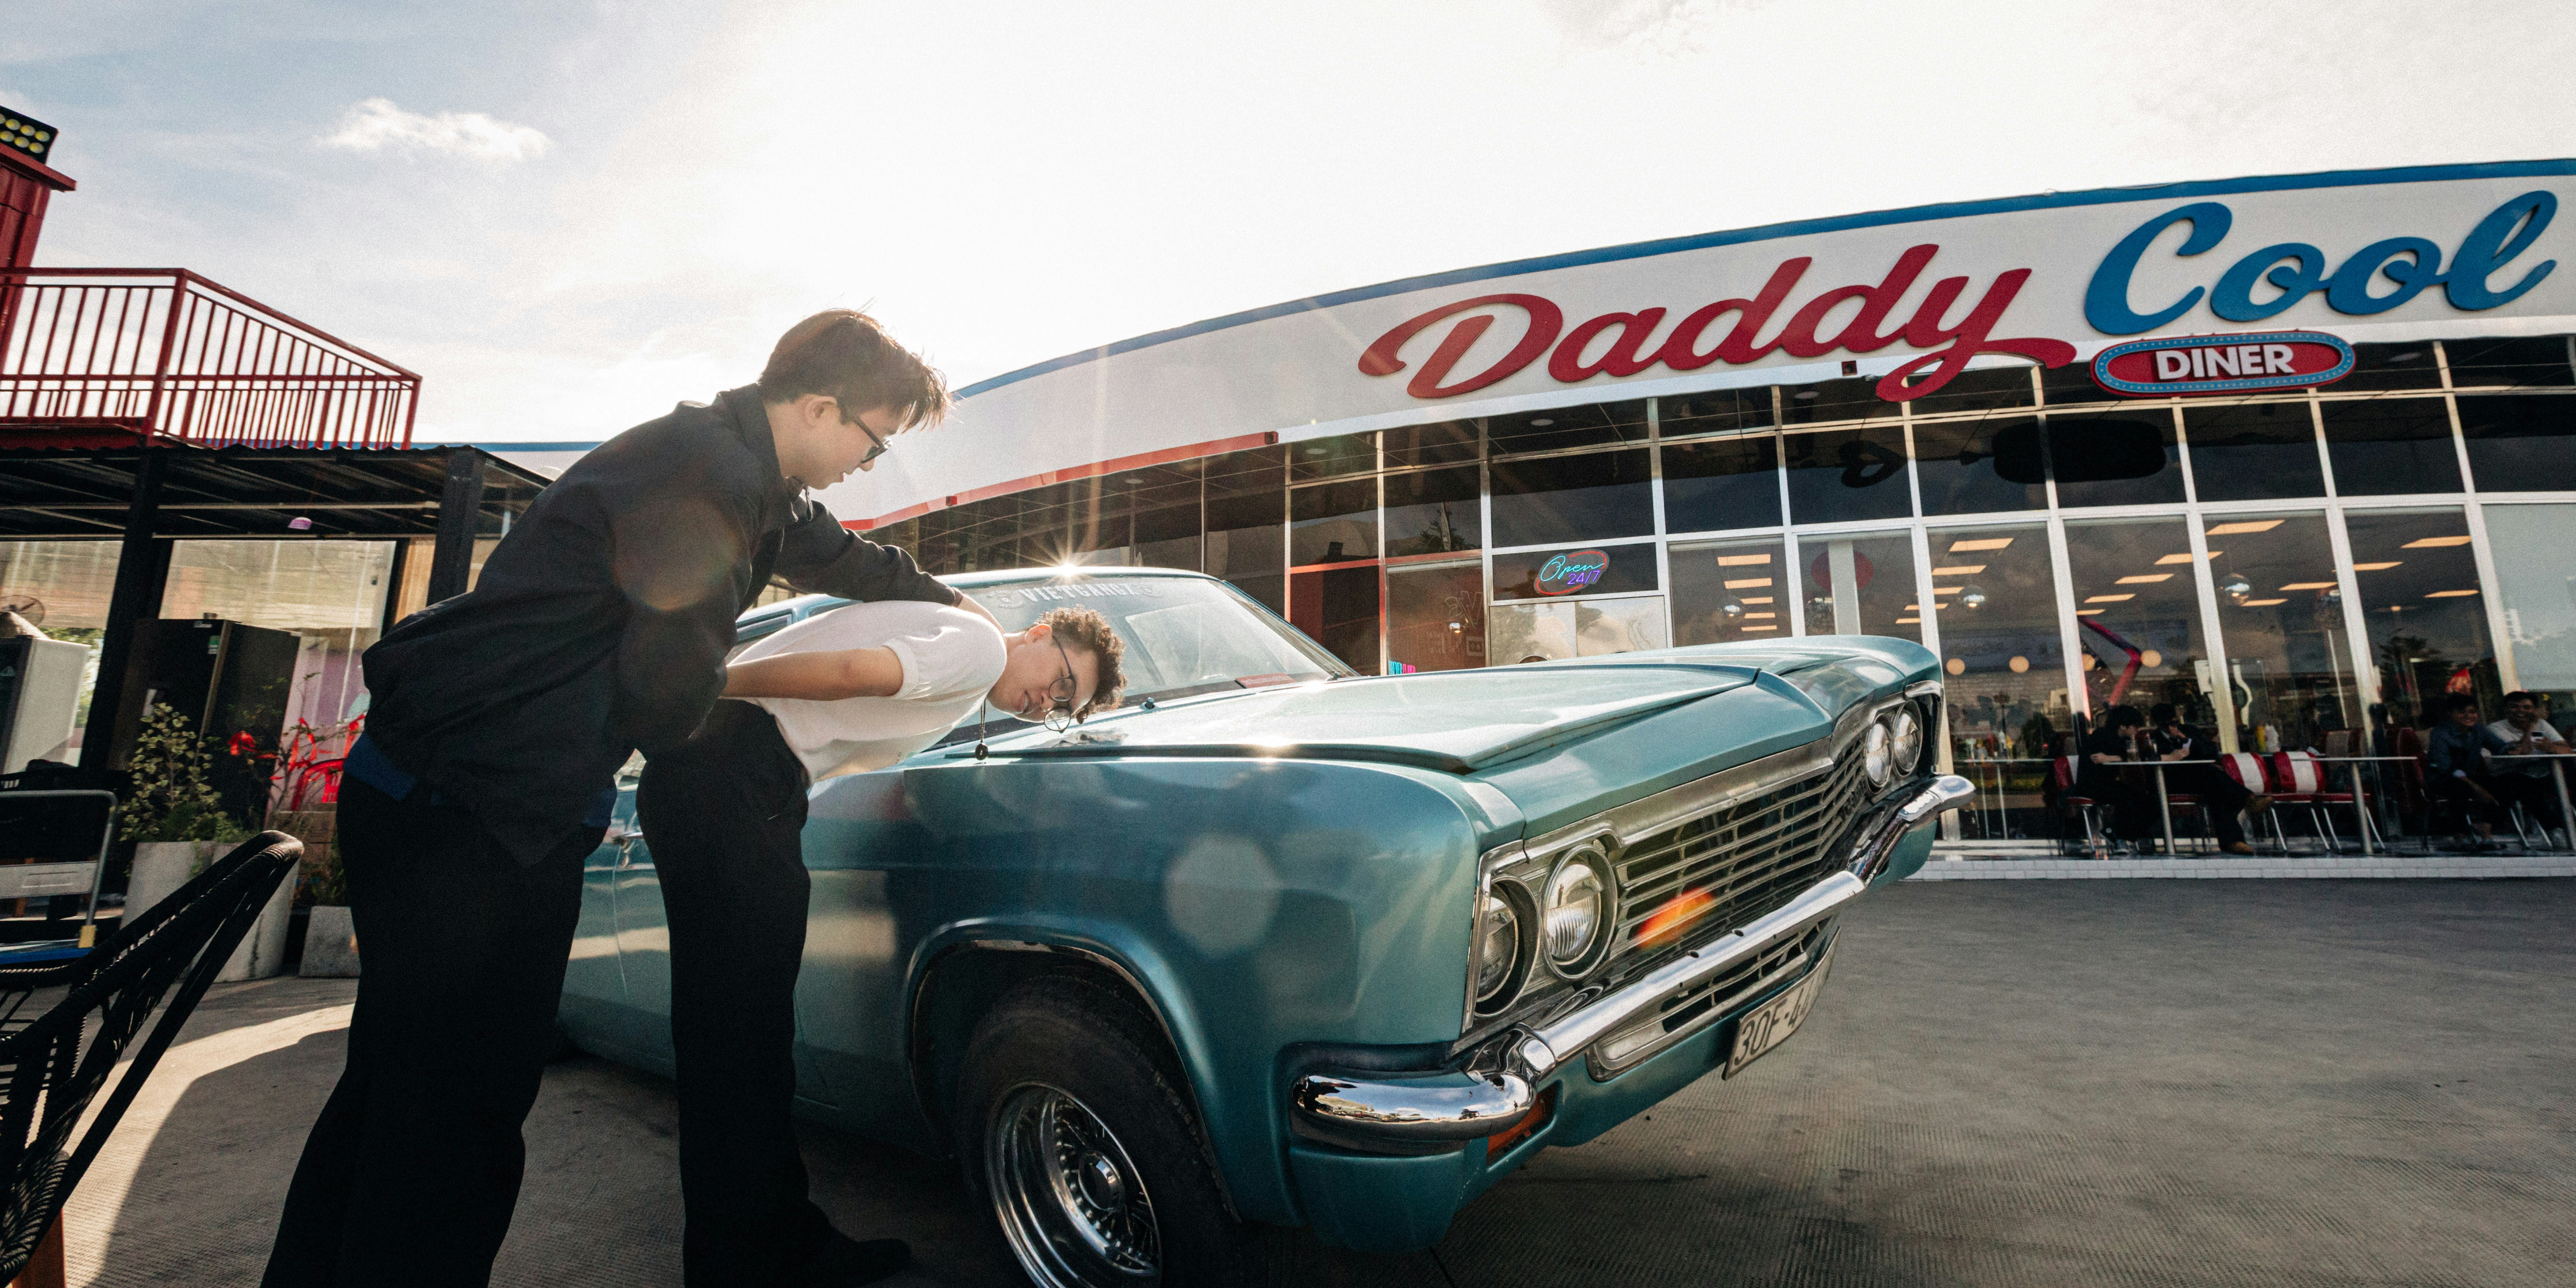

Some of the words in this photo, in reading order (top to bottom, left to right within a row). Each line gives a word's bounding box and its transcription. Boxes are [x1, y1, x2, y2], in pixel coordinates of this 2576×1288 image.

[1358, 244, 2077, 402] Daddy
[2084, 190, 2558, 335] Cool
[2155, 344, 2295, 381] DINER
[1540, 555, 1604, 581] Open
[1566, 570, 1600, 585] 24/7
